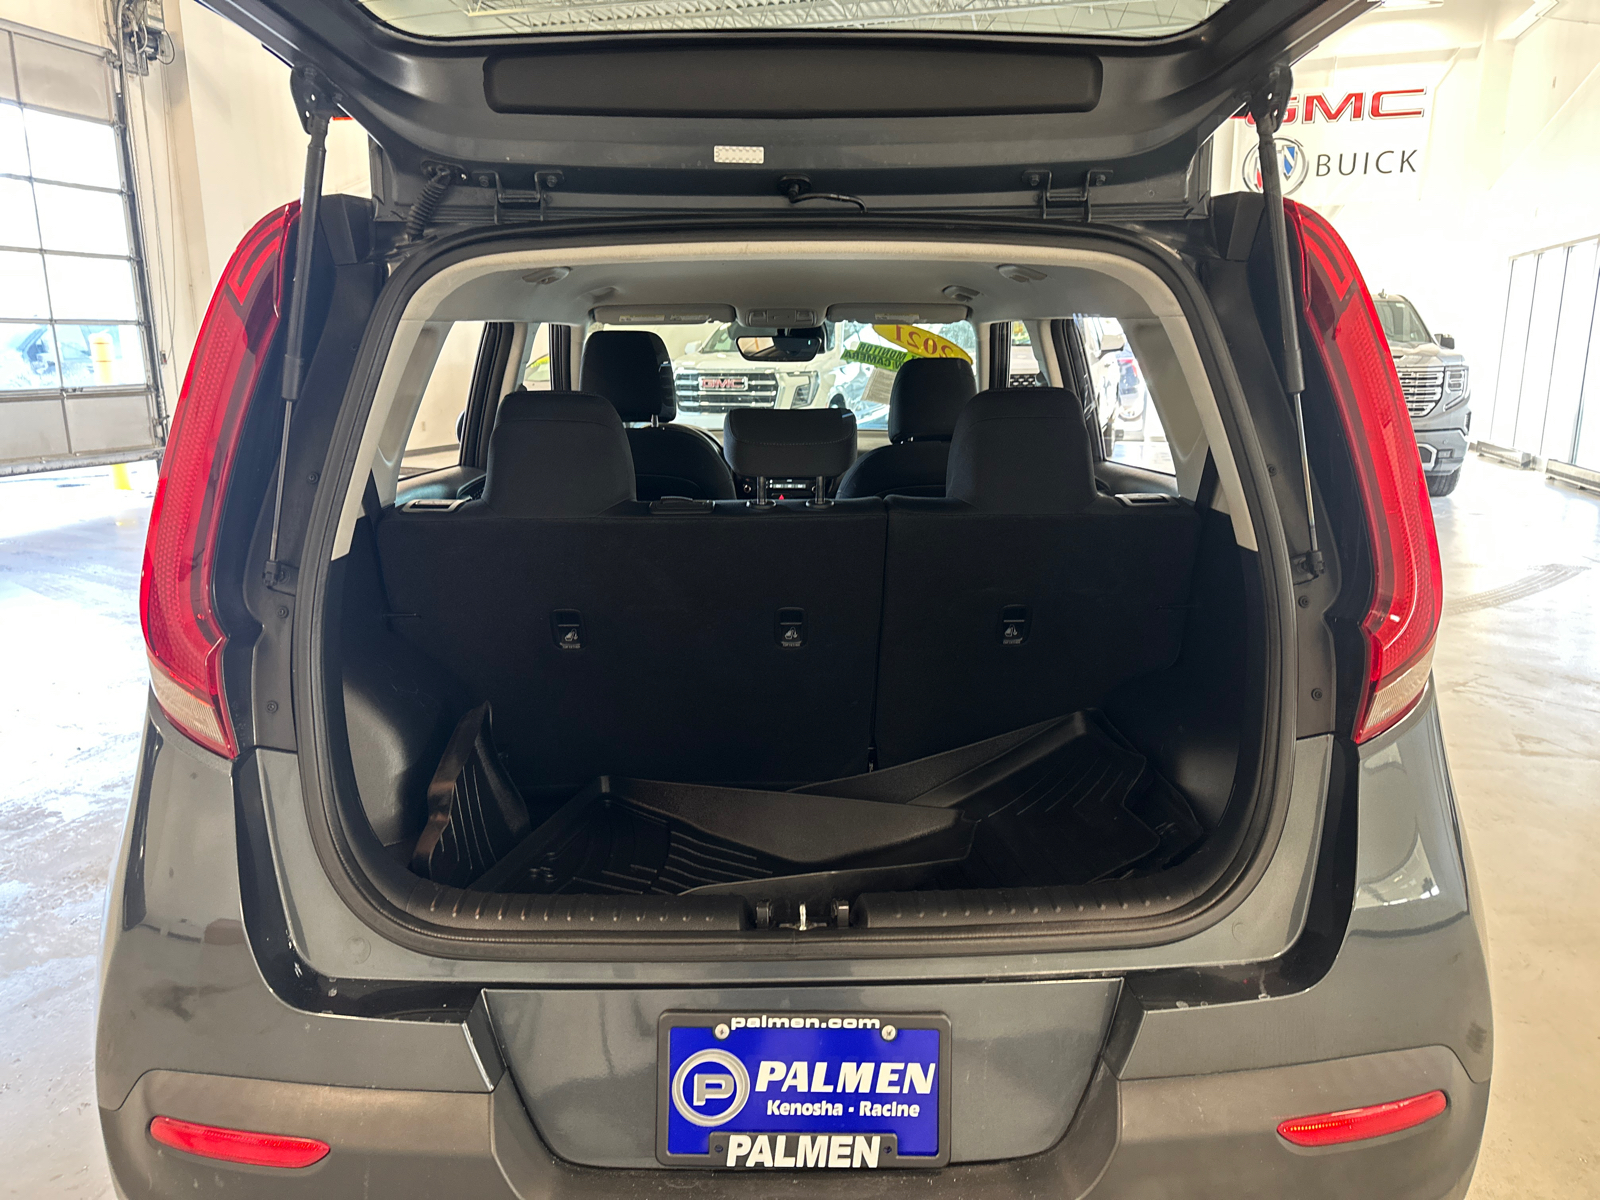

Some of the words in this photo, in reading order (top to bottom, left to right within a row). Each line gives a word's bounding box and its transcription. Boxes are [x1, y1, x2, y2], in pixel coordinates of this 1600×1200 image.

[1315, 149, 1419, 177] BUICK
[701, 378, 744, 389] GMC
[730, 1014, 881, 1030] palmen.com
[754, 1060, 936, 1095] PALMEN
[766, 1099, 843, 1117] Kenosha
[859, 1100, 920, 1118] Racine
[726, 1134, 881, 1169] PALMEN
